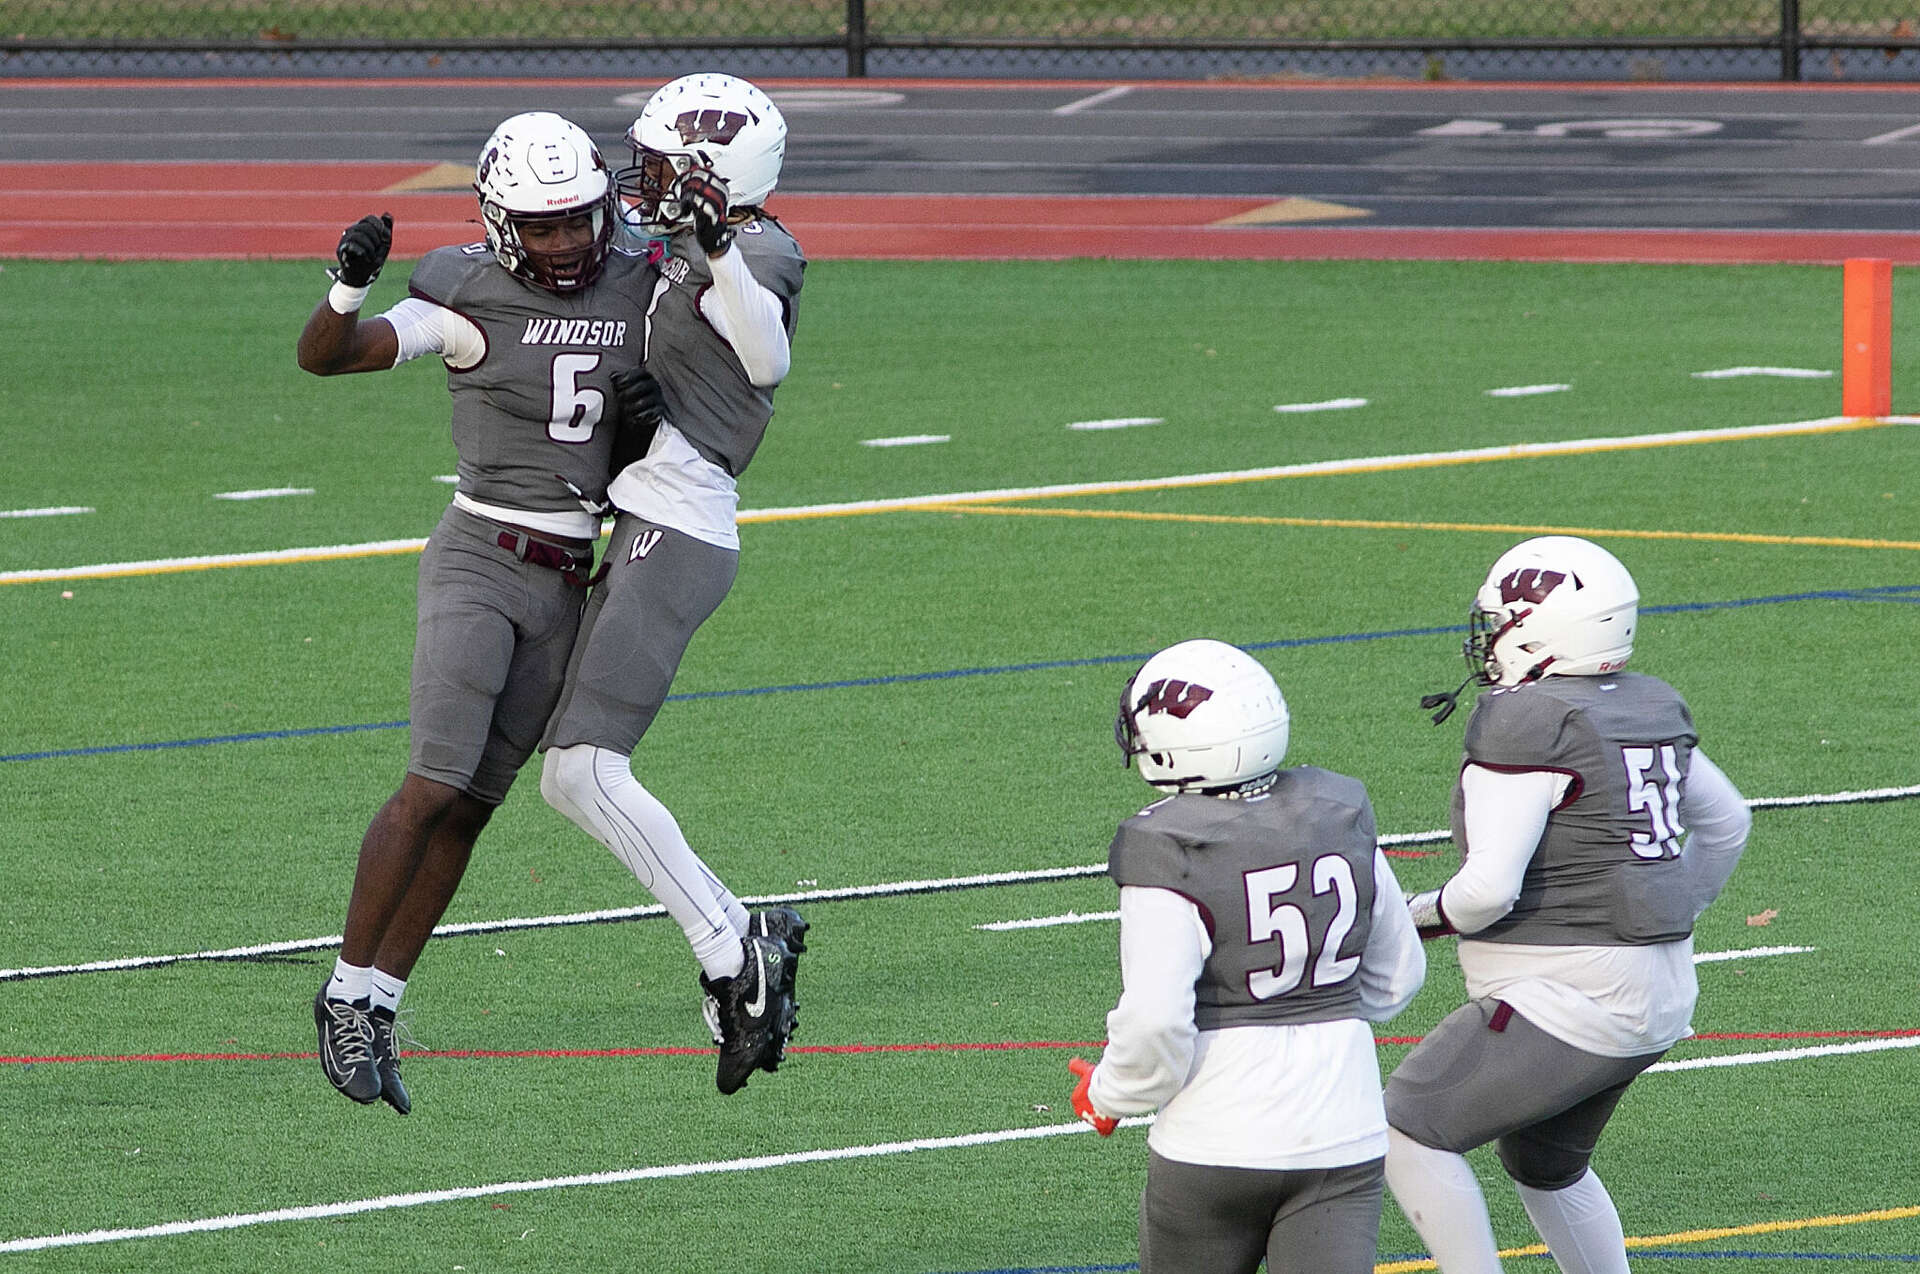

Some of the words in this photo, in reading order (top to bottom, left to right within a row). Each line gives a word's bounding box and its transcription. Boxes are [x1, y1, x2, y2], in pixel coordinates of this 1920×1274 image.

[521, 318, 627, 347] WINDSOR
[546, 352, 604, 444] 6
[626, 528, 664, 565] W
[1620, 743, 1685, 861] 51
[1243, 852, 1363, 1001] 52
